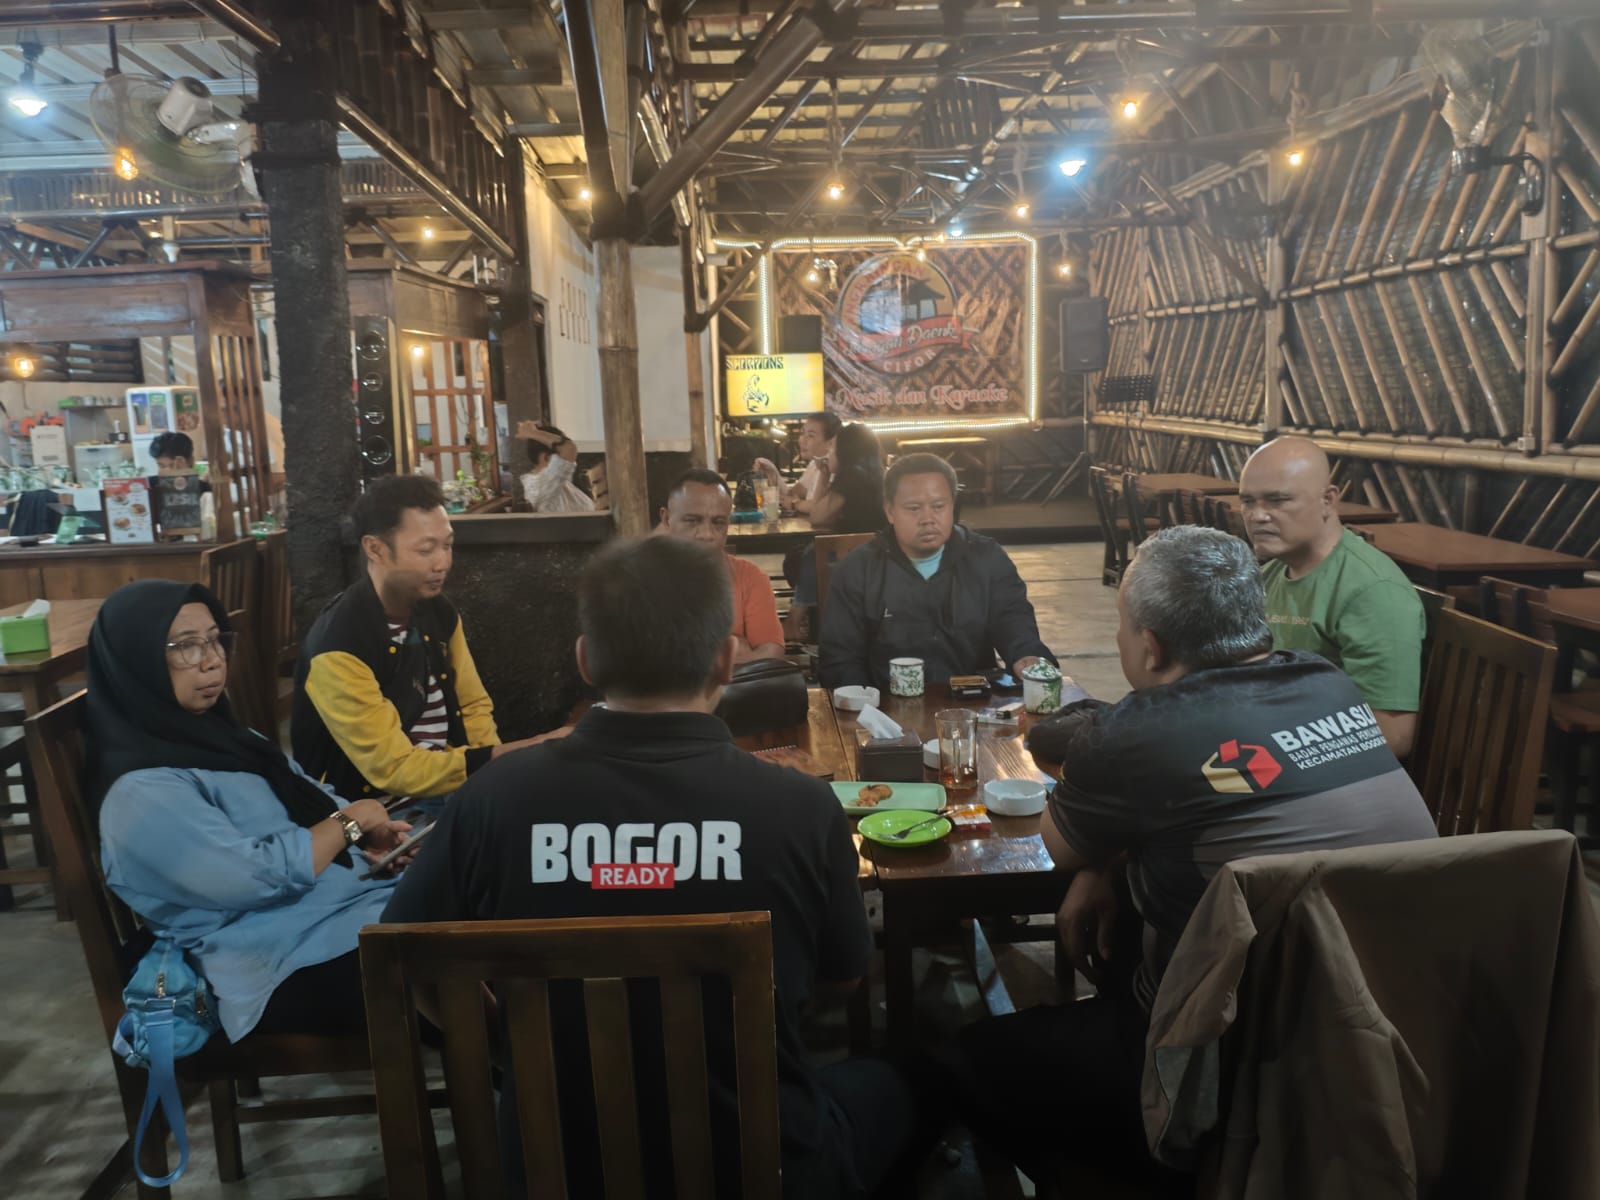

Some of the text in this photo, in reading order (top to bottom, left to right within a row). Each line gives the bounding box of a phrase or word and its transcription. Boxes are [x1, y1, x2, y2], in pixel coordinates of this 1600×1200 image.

[883, 348, 936, 374] CIFOR
[895, 386, 927, 405] dan
[930, 383, 1008, 410] Karaoke
[1287, 746, 1321, 763] BADAN
[1318, 733, 1360, 753] PENGAWAS
[1296, 744, 1361, 770] KECAMATAN
[531, 820, 744, 883] BOGOR
[599, 867, 670, 886] READY
